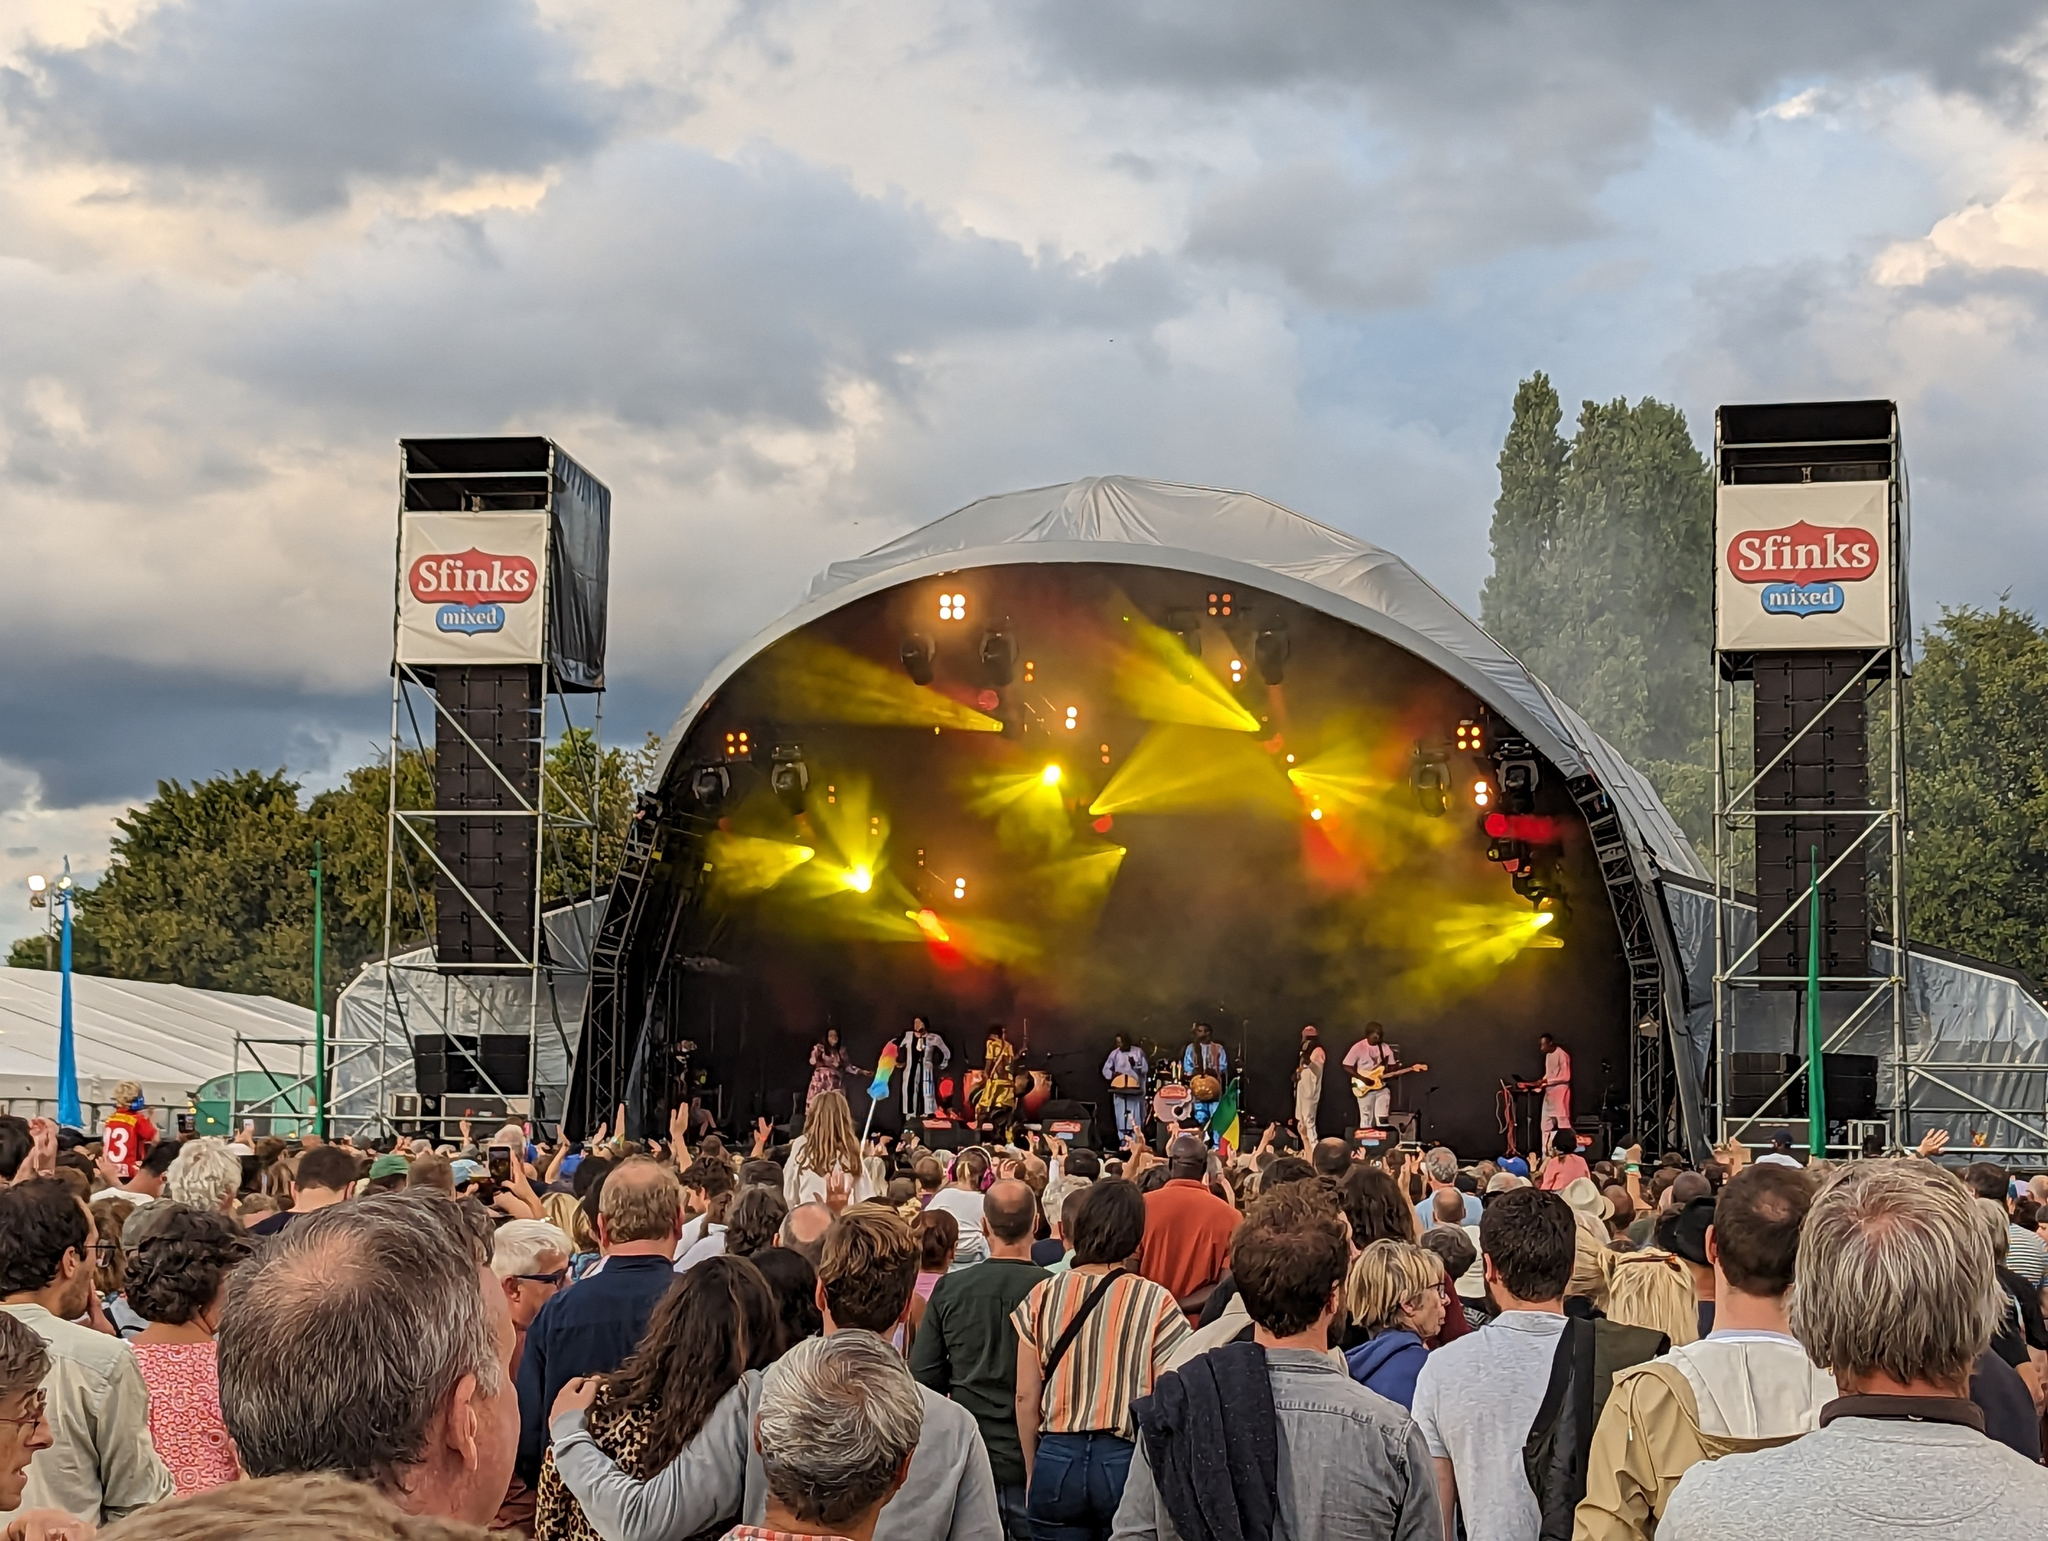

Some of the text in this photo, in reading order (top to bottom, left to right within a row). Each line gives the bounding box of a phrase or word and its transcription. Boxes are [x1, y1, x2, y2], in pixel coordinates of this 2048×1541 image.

[1738, 533, 1871, 571] Sfinks
[417, 560, 530, 592] Sfinks
[1769, 587, 1834, 606] mixed
[443, 607, 497, 625] mixed
